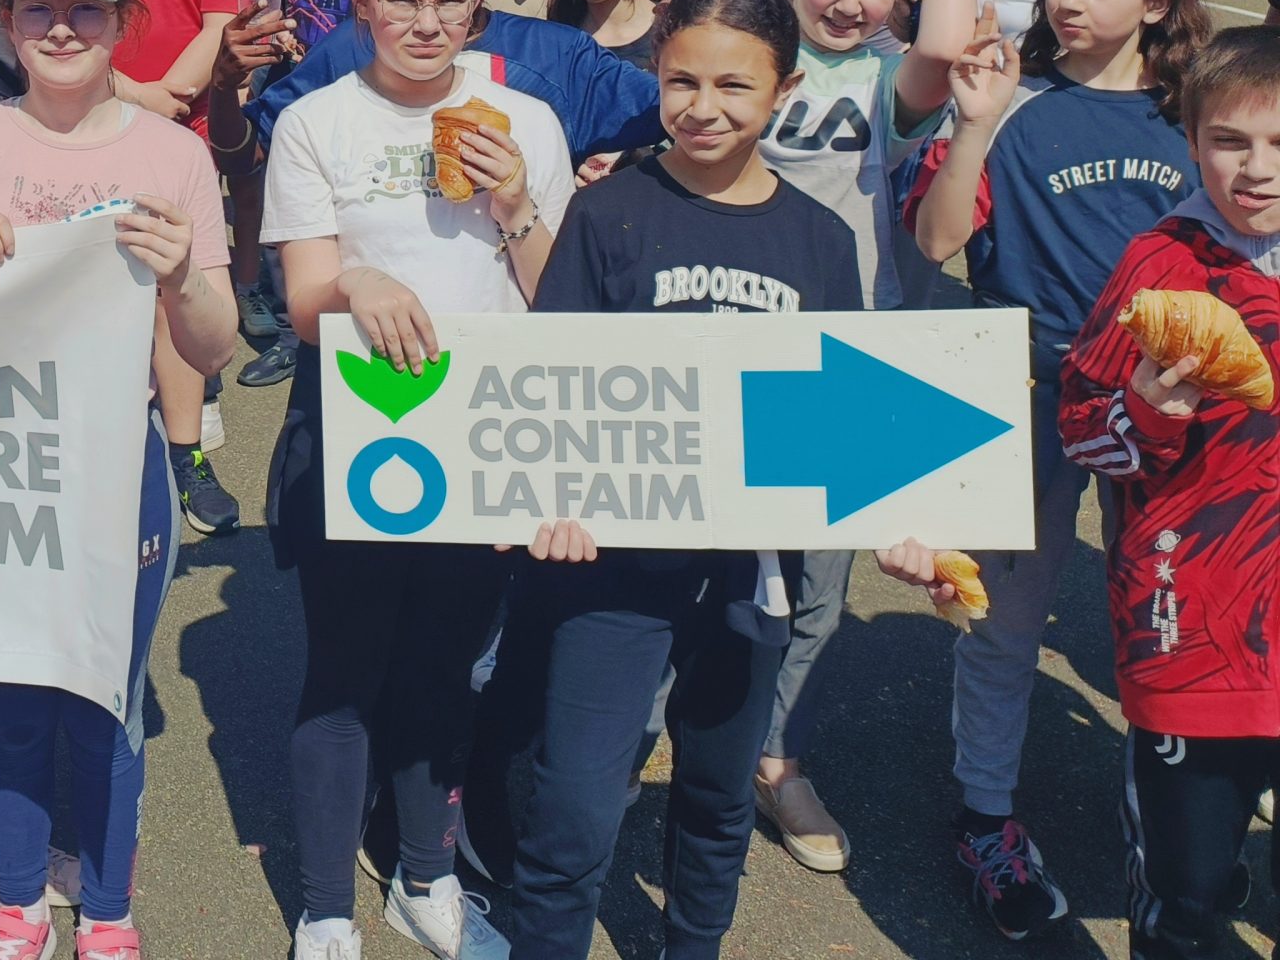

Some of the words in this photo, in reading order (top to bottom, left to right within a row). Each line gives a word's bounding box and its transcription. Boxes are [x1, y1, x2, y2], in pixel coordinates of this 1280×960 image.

[1048, 159, 1116, 194] STREET
[1123, 158, 1182, 191] MATCH
[653, 264, 800, 312] BROOKLYN
[468, 365, 700, 413] ACTION
[468, 418, 701, 465] CONTRE
[471, 470, 543, 517] LA
[556, 472, 705, 521] FAIM
